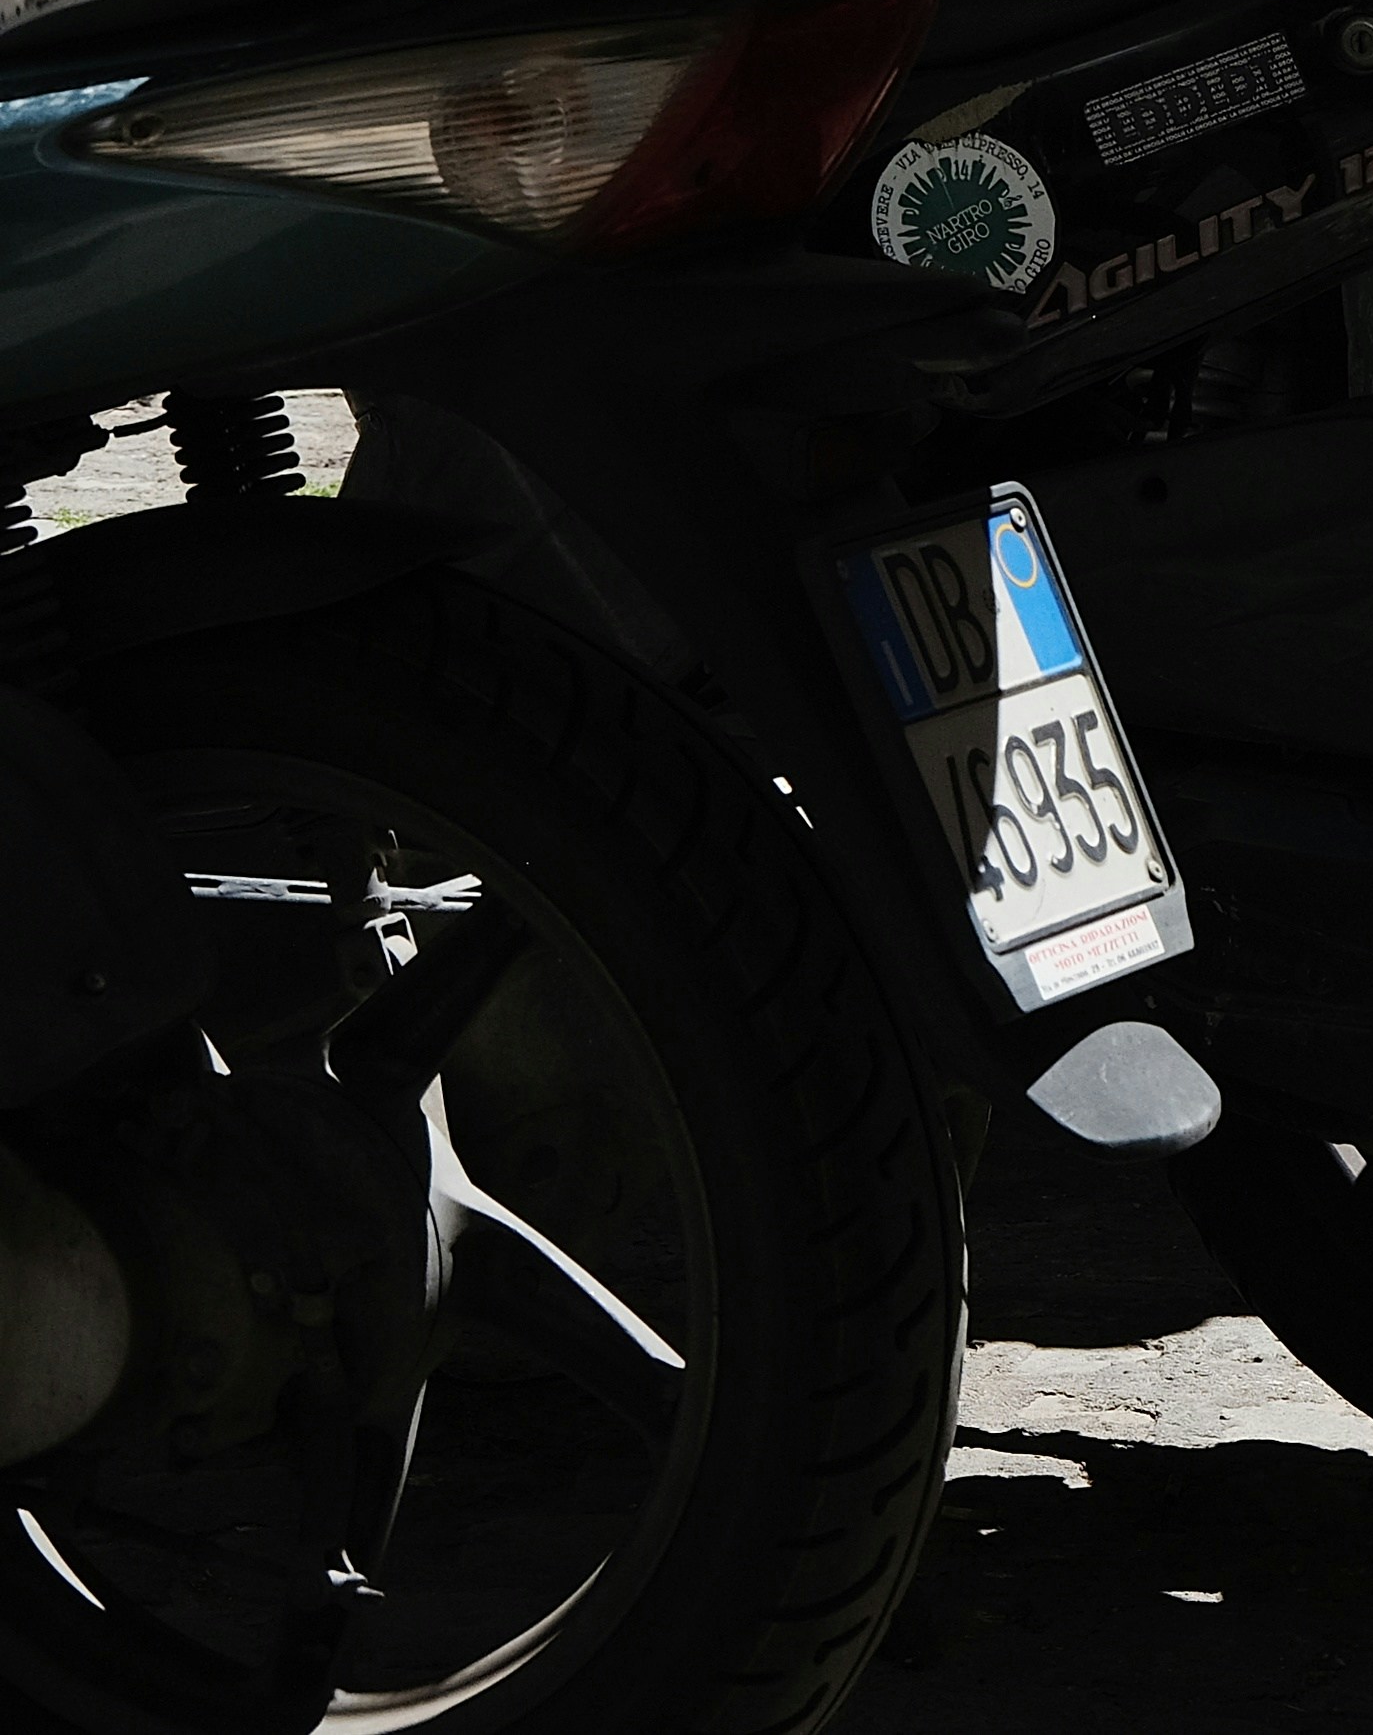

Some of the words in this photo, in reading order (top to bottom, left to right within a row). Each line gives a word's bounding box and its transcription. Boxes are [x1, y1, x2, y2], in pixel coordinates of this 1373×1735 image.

[895, 149, 921, 171] VIA
[1027, 181, 1045, 200] 14
[947, 221, 991, 254] GIRO
[1026, 173, 1317, 330] AGILITY
[1025, 239, 1051, 279] GIRO
[882, 541, 995, 695] DB
[945, 709, 1140, 902] 46935
